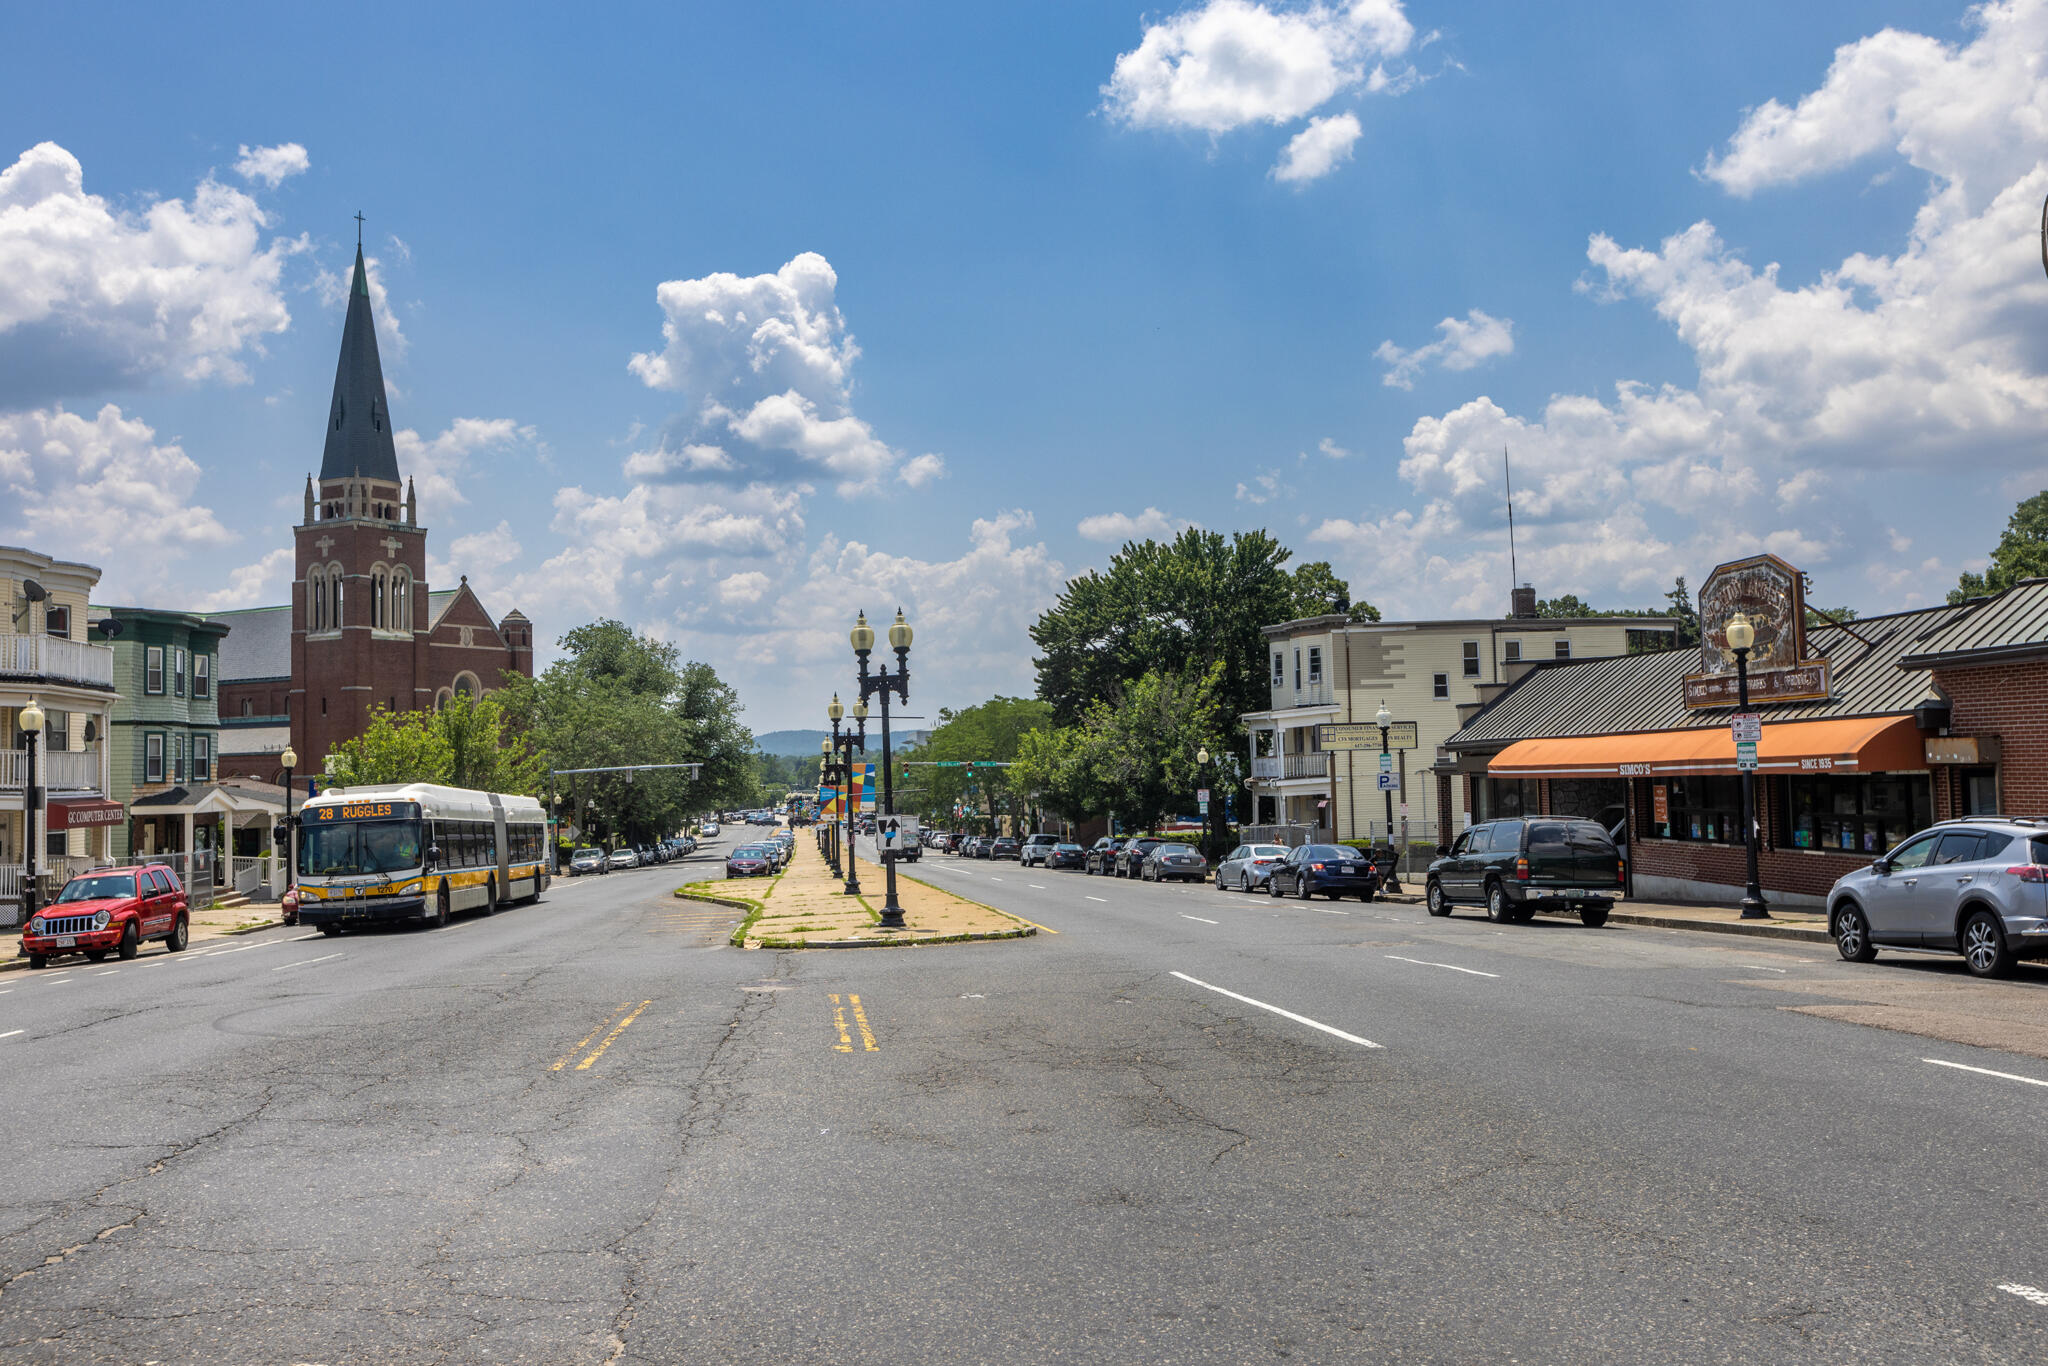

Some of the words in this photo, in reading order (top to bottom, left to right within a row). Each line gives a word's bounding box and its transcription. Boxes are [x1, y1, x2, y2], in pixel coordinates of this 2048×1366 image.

[1620, 763, 1650, 775] SIMCO'S
[1801, 759, 1817, 769] SINCE
[76, 810, 104, 822] COMPUTER
[104, 809, 123, 820] CENTER
[319, 808, 333, 820] 28
[342, 804, 391, 818] RUGGLES
